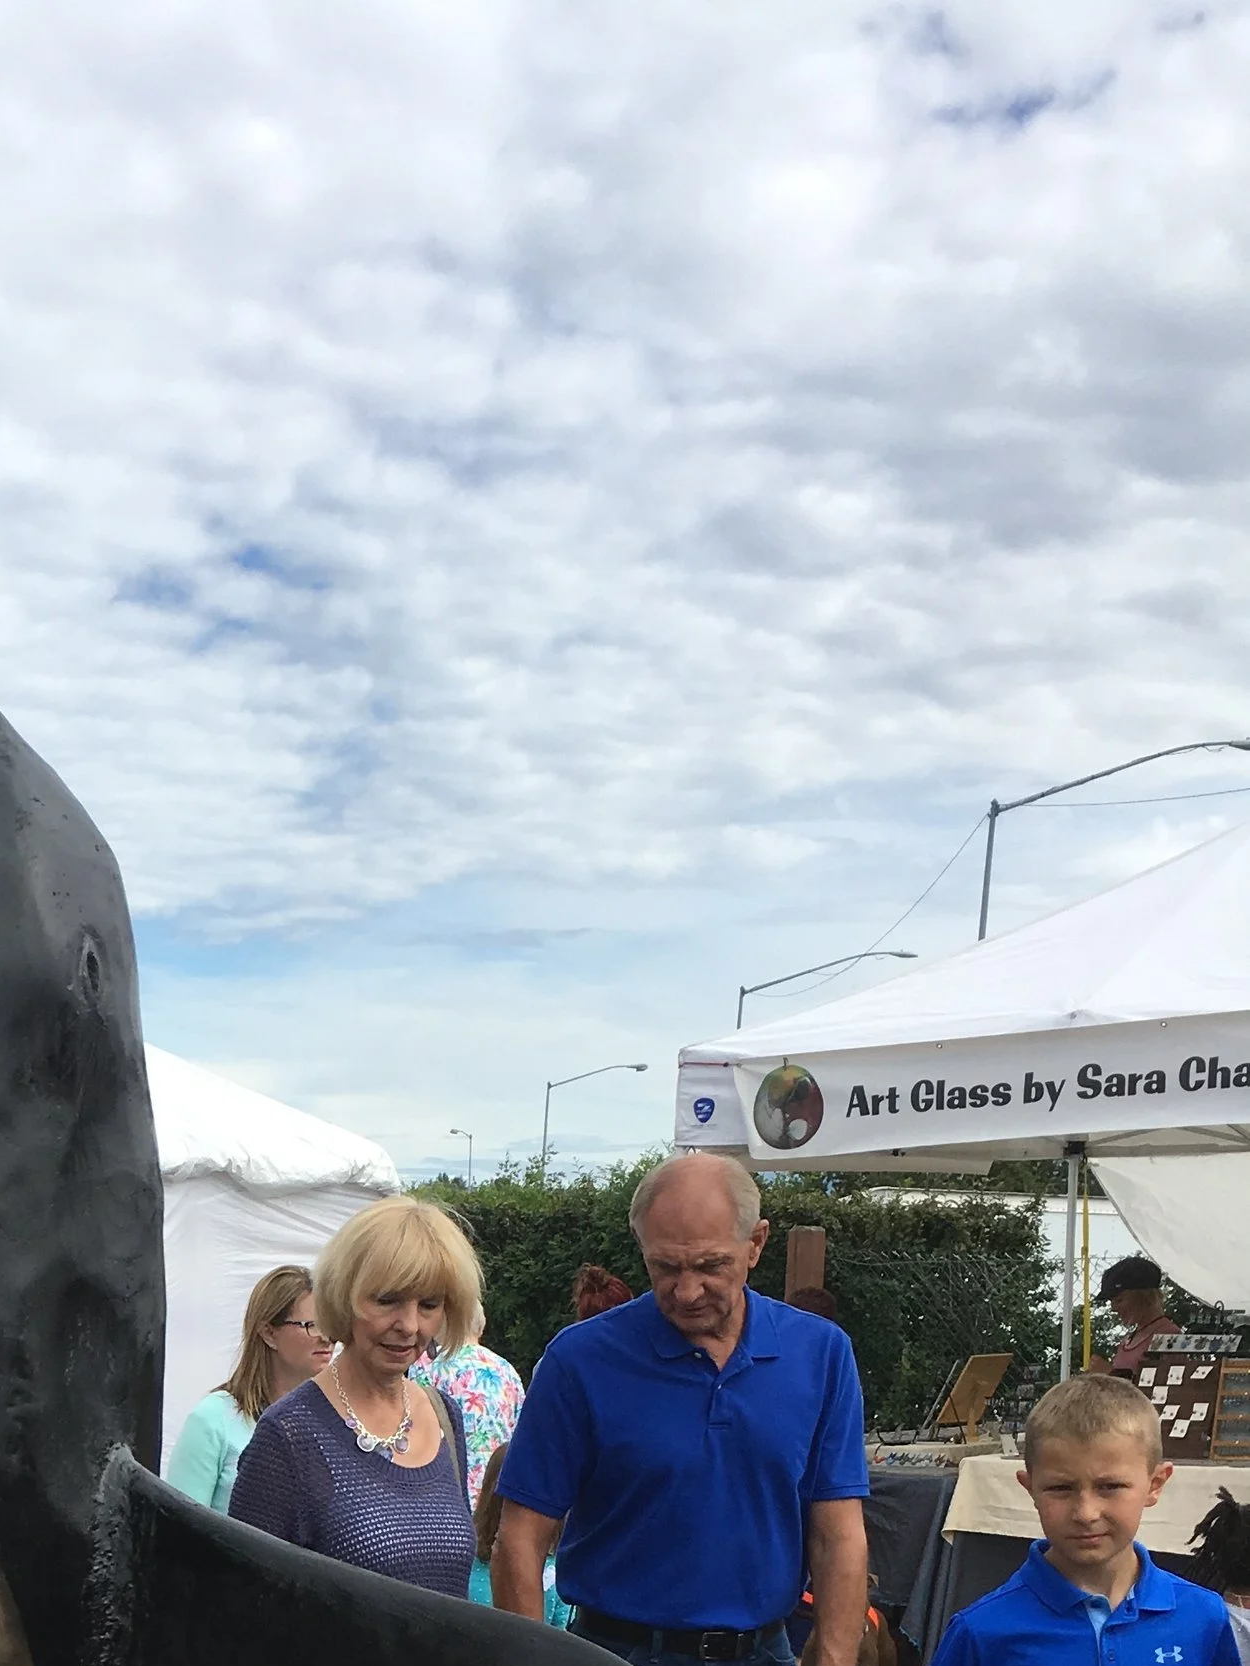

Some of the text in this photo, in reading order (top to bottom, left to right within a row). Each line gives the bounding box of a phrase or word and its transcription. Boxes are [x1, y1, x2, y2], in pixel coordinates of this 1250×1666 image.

[846, 1055, 1250, 1118] Art Glass by Sara Cha
